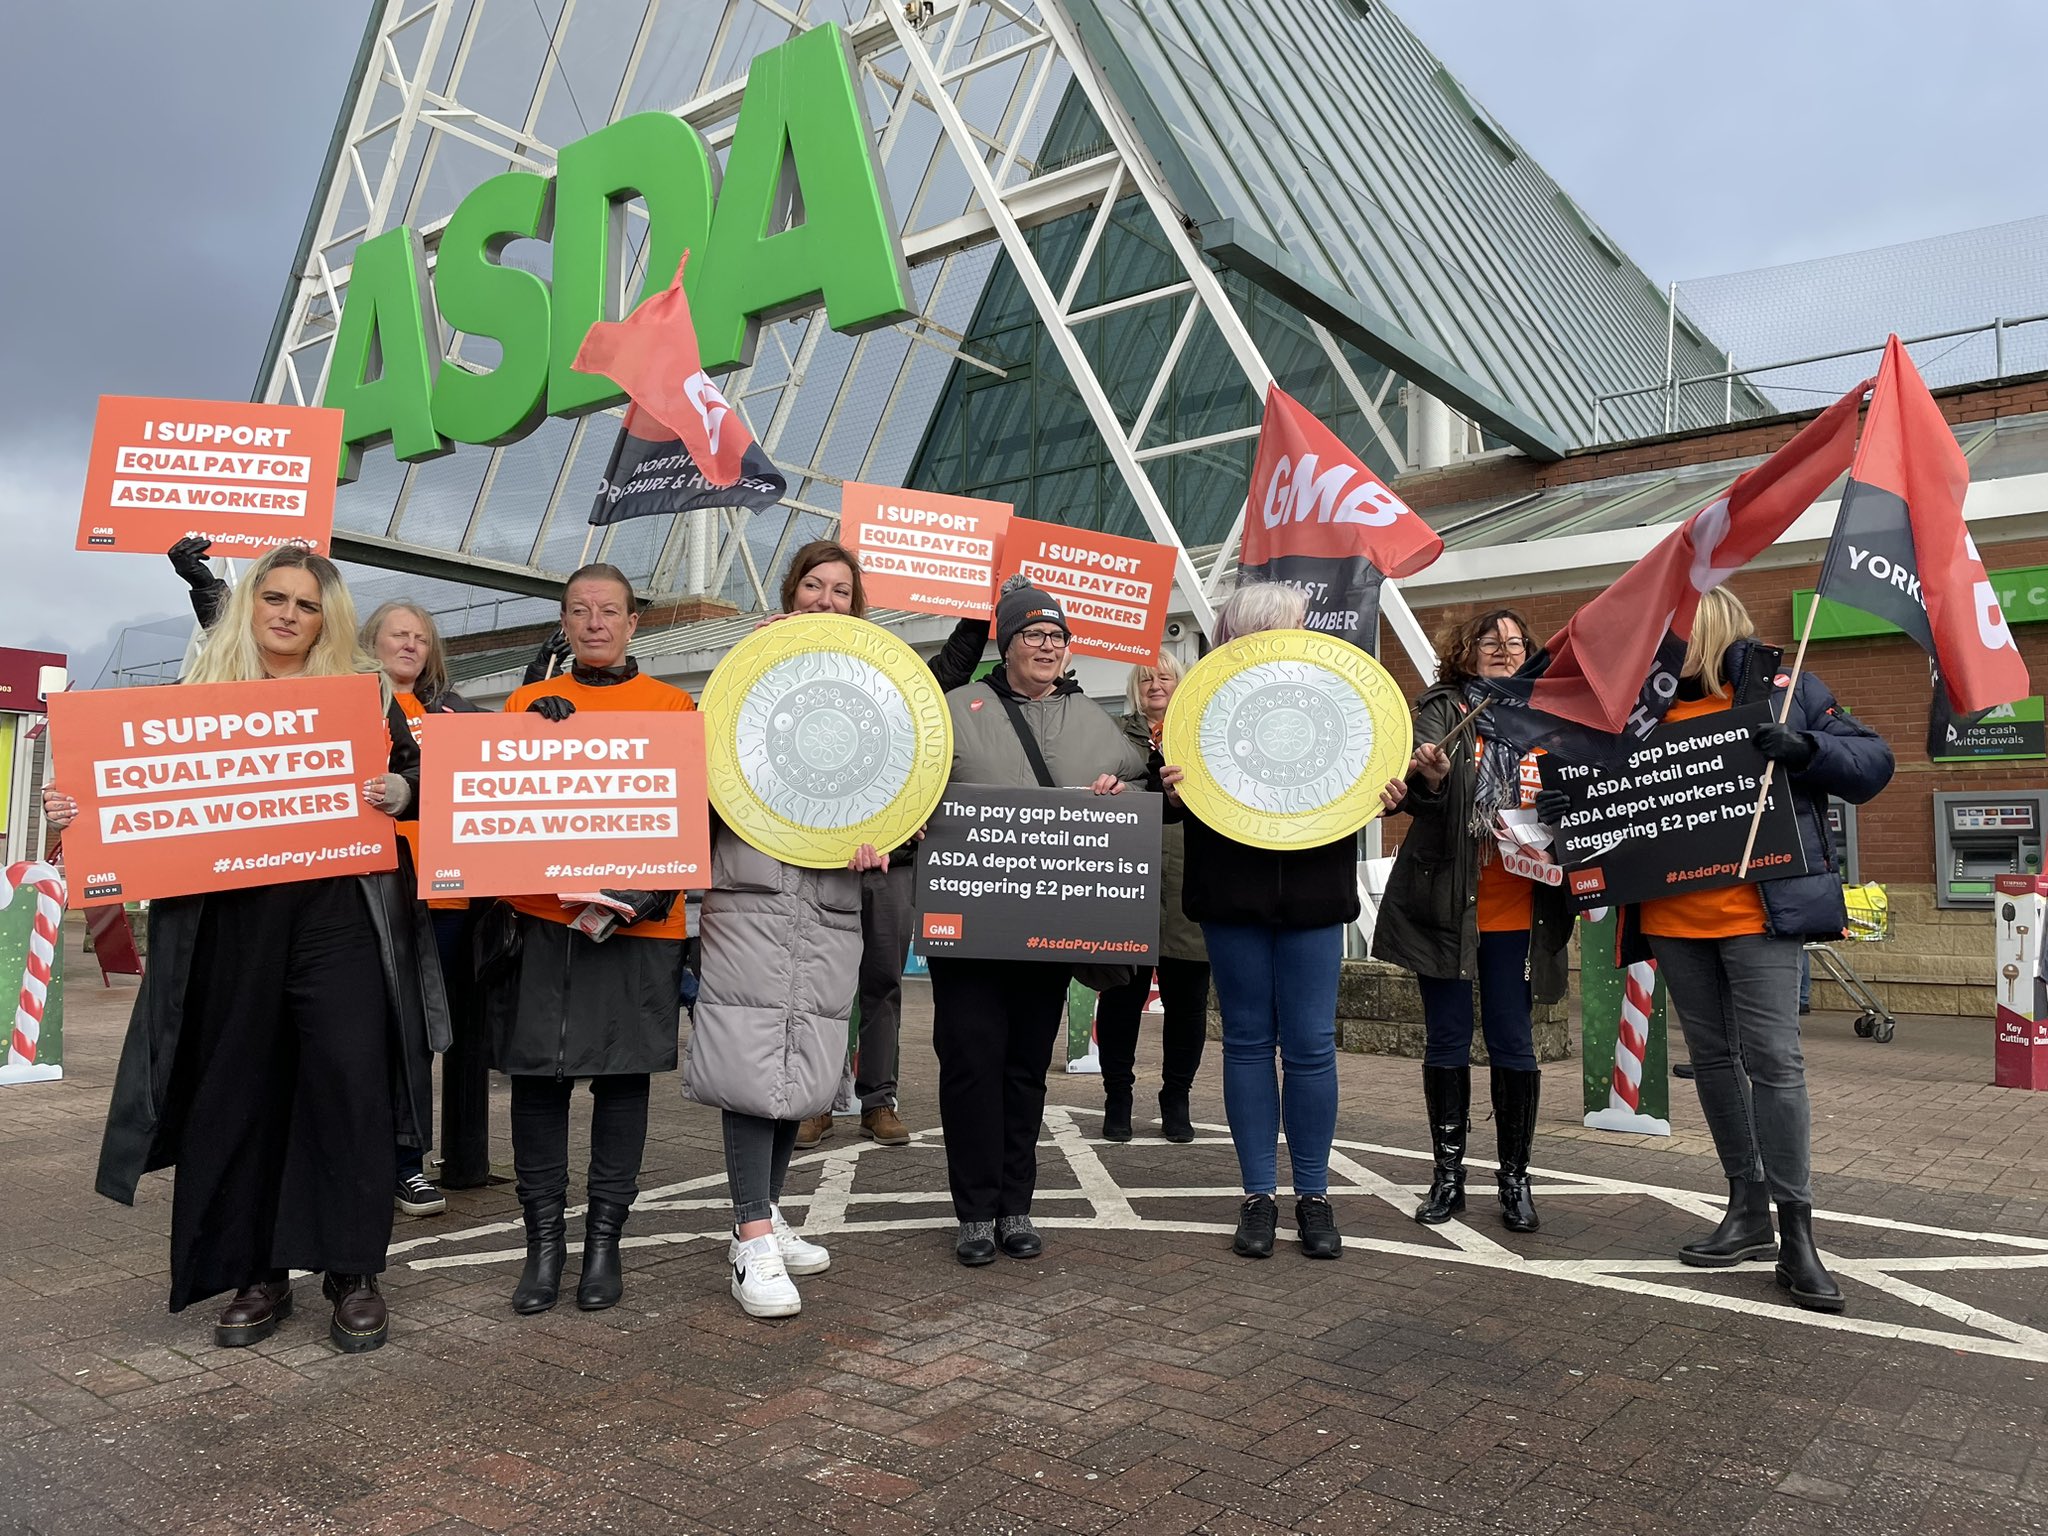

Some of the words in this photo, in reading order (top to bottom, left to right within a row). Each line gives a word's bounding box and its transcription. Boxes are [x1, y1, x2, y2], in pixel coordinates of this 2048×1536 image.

[323, 20, 918, 484] ASDA
[143, 420, 153, 440] I
[157, 421, 292, 448] SUPPORT
[123, 452, 199, 471] EQUAL
[204, 456, 254, 475] PAY
[257, 459, 305, 477] FOR
[670, 474, 685, 490] &
[1263, 453, 1409, 530] GMB
[117, 486, 182, 504] ASDA
[187, 489, 300, 511] WORKERS
[92, 526, 114, 535] GMB
[876, 504, 884, 519] I
[887, 505, 979, 532] SUPPORT
[864, 528, 918, 547] EQUAL
[921, 536, 955, 551] PAY
[957, 541, 989, 556] FOR
[863, 555, 907, 572] ASDA
[910, 560, 987, 582] WORKERS
[1039, 541, 1046, 558] I
[1049, 543, 1141, 575] SUPPORT
[1024, 565, 1076, 587] EQUAL
[1079, 575, 1115, 593] PAY
[1115, 582, 1148, 600] FOR
[909, 592, 994, 611] #AsdaPayJustic
[1066, 600, 1142, 625] WORKERS
[1069, 634, 1151, 656] AsdaPayJustice
[1230, 637, 1287, 662] TWO
[1302, 638, 1390, 698] POUNDS
[851, 629, 900, 667] TWO
[903, 671, 944, 775] POUNDS
[122, 721, 135, 747] I
[142, 708, 319, 747] SUPPORT
[1990, 725, 2016, 735] cash
[481, 740, 490, 762] I
[497, 738, 650, 762] SUPPORT
[1954, 735, 2024, 747] withdrawals
[1557, 764, 1589, 781] The
[1628, 744, 1663, 768] gap
[1665, 727, 1750, 757] between
[103, 760, 211, 789] EQUAL
[216, 753, 280, 779] PAY
[286, 748, 346, 773] FOR
[1586, 777, 1632, 799] ASDA
[1634, 764, 1683, 788] retail
[1685, 755, 1724, 777] and
[461, 777, 551, 798] EQUAL
[557, 775, 613, 794] PAY
[618, 774, 670, 793] FOR
[711, 764, 757, 822] 2015
[110, 806, 199, 835] ASDA
[203, 792, 350, 825] WORKERS
[943, 801, 977, 818] The
[979, 803, 1016, 824] pay
[1019, 807, 1056, 826] gap
[1060, 807, 1139, 825] between
[1560, 808, 1604, 829] ASDA
[1605, 794, 1656, 818] depot
[1658, 781, 1735, 807] workers
[1737, 774, 1756, 790] is
[460, 816, 537, 836] ASDA
[541, 813, 671, 834] WORKERS
[1222, 806, 1281, 839] 2015
[1565, 820, 1658, 851] staggering
[1660, 814, 1684, 832] £2
[1686, 808, 1718, 831] per
[966, 827, 1017, 845] ASDA
[1021, 828, 1069, 846] retail
[1073, 832, 1110, 848] and
[213, 842, 382, 873] #AsdaPayJustice
[544, 860, 698, 879] #AsdaPayJustice
[927, 851, 979, 868] ASDA
[982, 852, 1037, 873] depot
[1040, 855, 1115, 874] workers
[1118, 858, 1133, 875] is
[1136, 862, 1149, 875] a
[1666, 853, 1792, 883] #AsdaPayustice
[86, 872, 117, 884] GMB
[435, 869, 461, 878] GMB
[1576, 878, 1599, 890] GMB
[88, 888, 118, 896] UNION
[929, 877, 1032, 899] staggering
[1035, 880, 1058, 896] £2
[1061, 883, 1093, 901] per
[1096, 883, 1145, 900] hour!
[929, 925, 956, 936] GMB
[1026, 936, 1149, 953] #AsdaPayJustice
[2000, 1032, 2029, 1046] Cutting
[2006, 1022, 2022, 1034] Key
